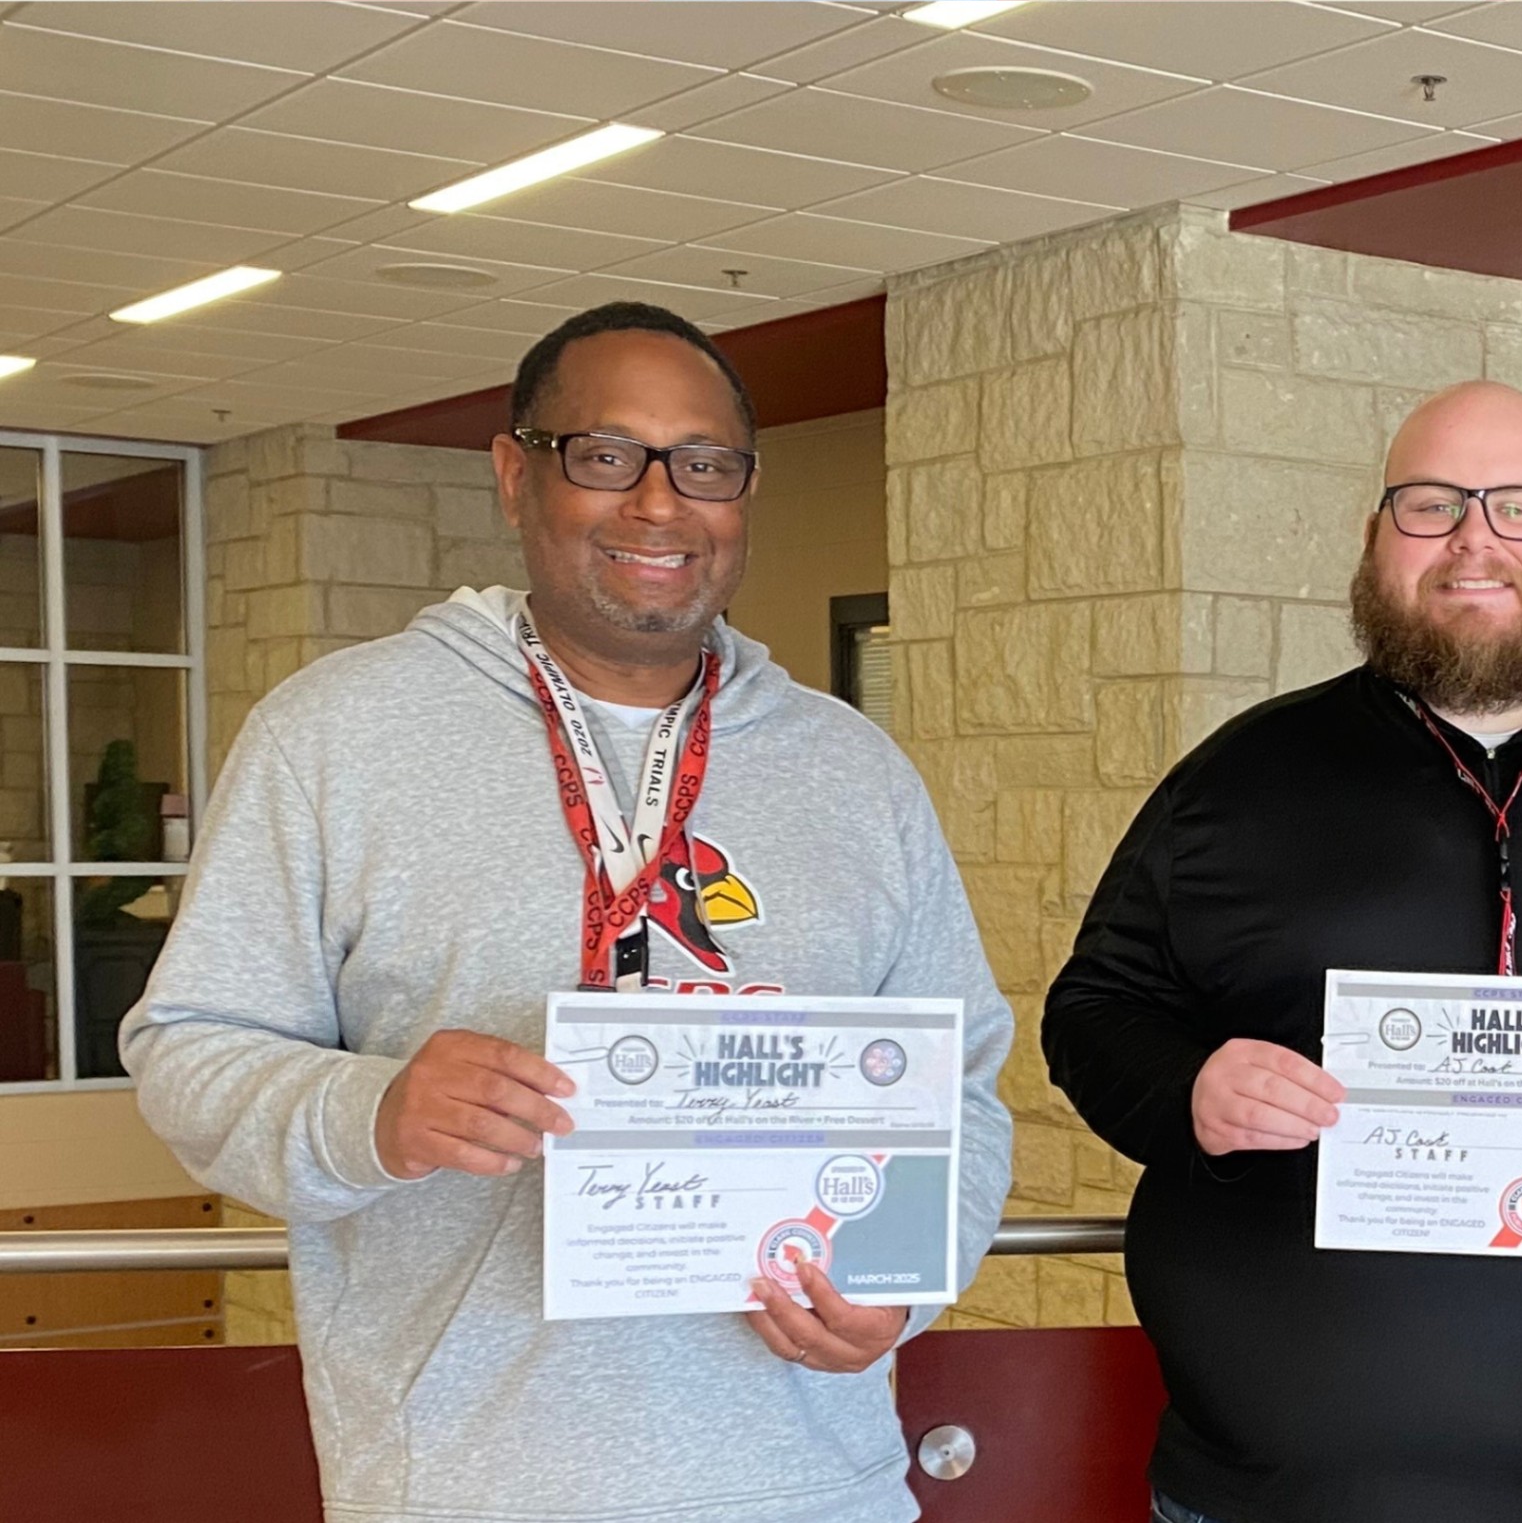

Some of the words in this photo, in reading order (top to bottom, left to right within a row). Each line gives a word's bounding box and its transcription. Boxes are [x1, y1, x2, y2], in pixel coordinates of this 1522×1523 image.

[536, 653, 576, 712] OLYMPIC
[570, 719, 592, 757] 2020
[555, 753, 584, 809] CCPS
[645, 749, 668, 807] TRIALS
[673, 773, 699, 823] CCPS
[607, 877, 651, 928] CCPS
[718, 1034, 805, 1059] HALL'S
[694, 1061, 825, 1087] HIGHLIGHT
[1435, 1077, 1452, 1086] $20
[1453, 1077, 1467, 1086] off
[1452, 1094, 1511, 1105] ENGAGED
[1394, 1148, 1469, 1162] STAFF
[823, 1177, 874, 1197] Hall's
[635, 1194, 721, 1210] STAFF
[847, 1274, 891, 1285] MARCH
[892, 1273, 921, 1284] 2025
